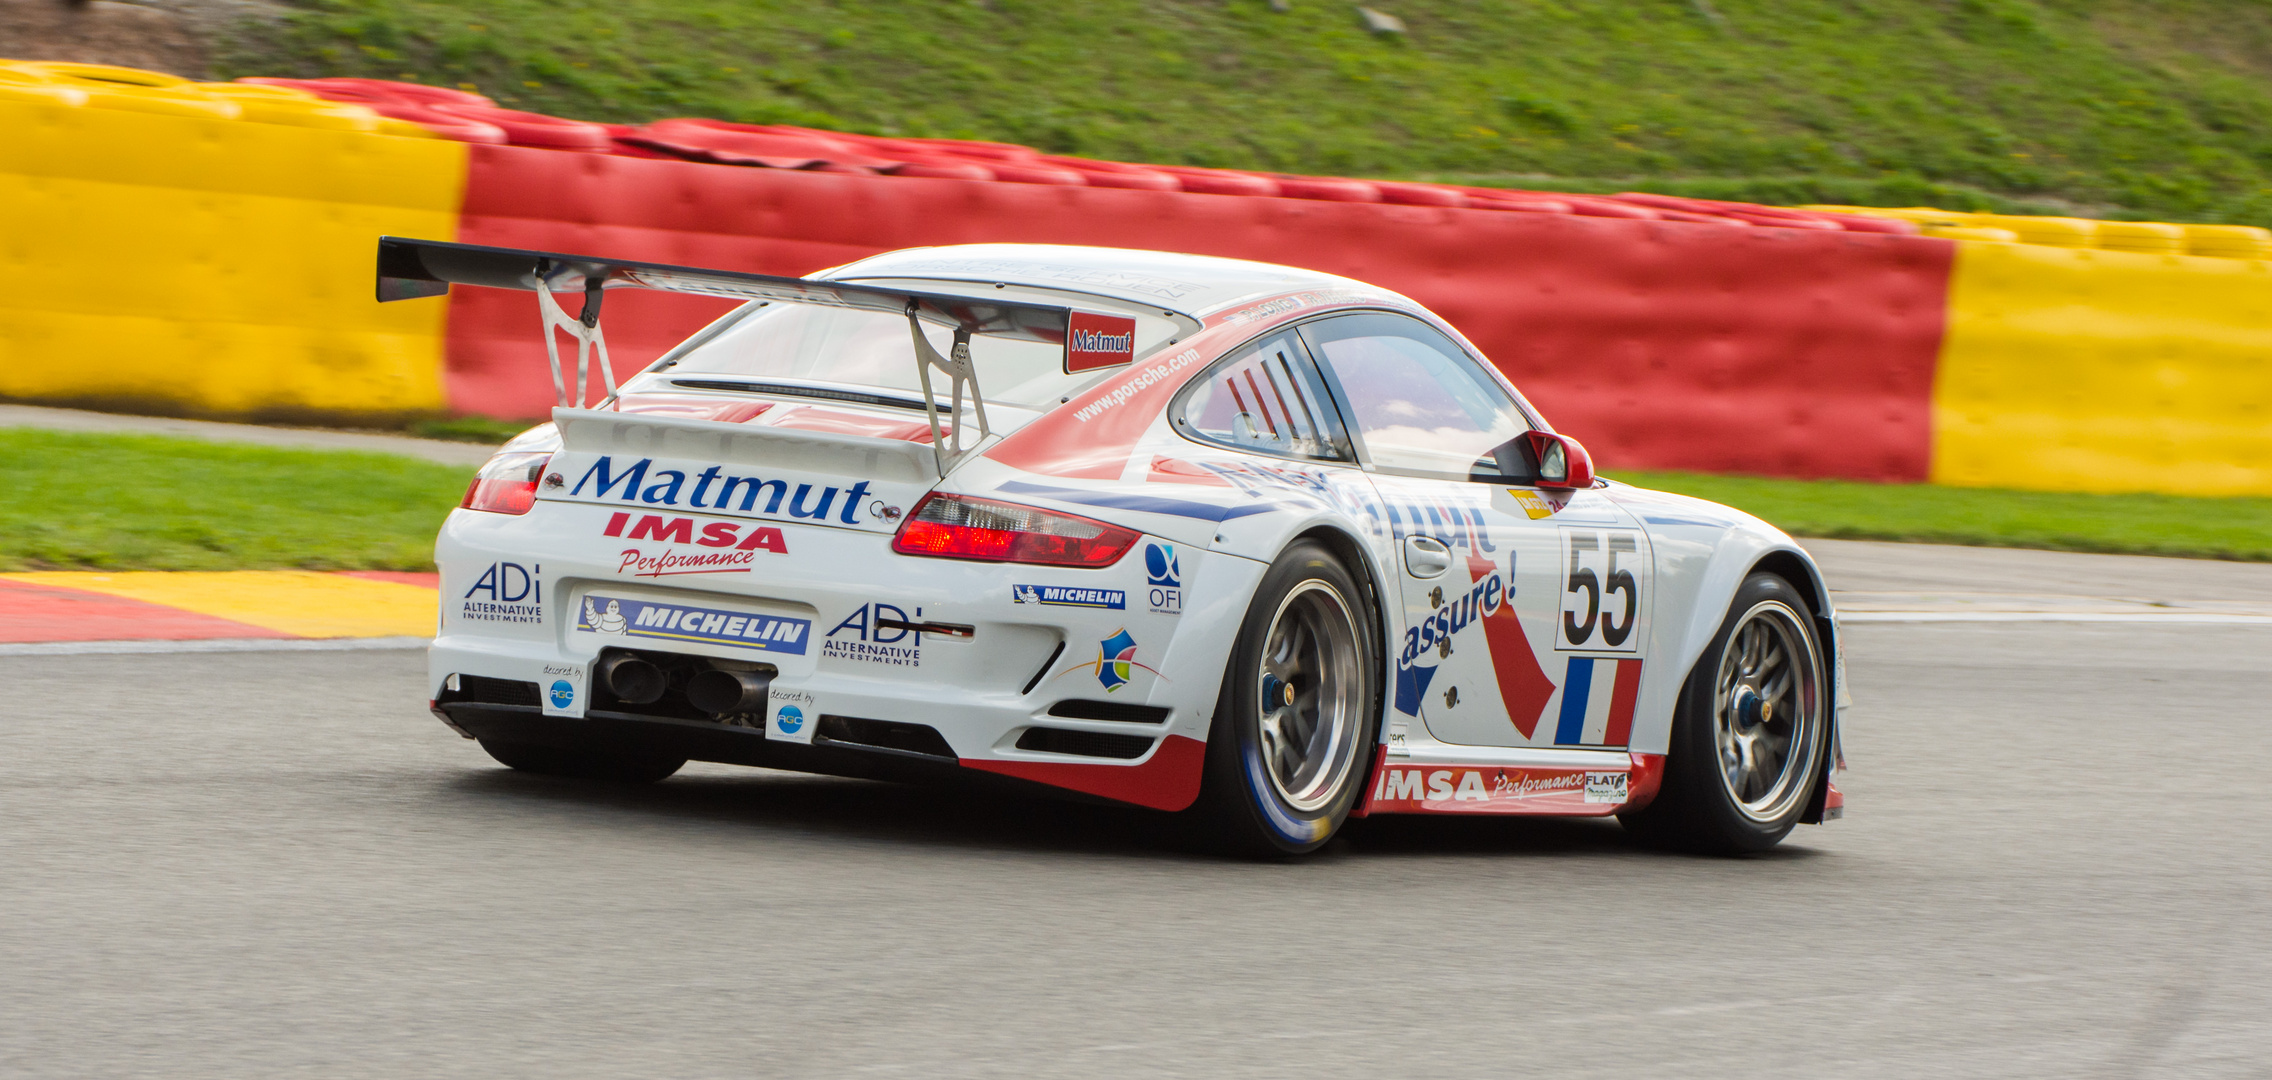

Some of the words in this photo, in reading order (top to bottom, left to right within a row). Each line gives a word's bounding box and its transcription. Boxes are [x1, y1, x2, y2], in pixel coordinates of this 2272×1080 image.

[1071, 329, 1131, 354] Matmut
[1073, 346, 1200, 424] www.porsche.com
[570, 456, 872, 525] Matmut
[603, 512, 789, 554] IMSA
[618, 549, 755, 577] Performance
[1043, 588, 1123, 604] MICHELIN
[1149, 588, 1181, 609] OFI
[1563, 531, 1637, 647] 55
[463, 602, 541, 616] ALTERNATIVE
[463, 612, 542, 623] INVESTMENTS
[634, 605, 804, 643] MICHELIN
[823, 650, 919, 667] INVESTMENTS
[824, 640, 920, 659] ALTERNATIVE
[543, 664, 572, 676] decored
[575, 667, 584, 682] by
[550, 689, 573, 700] AGC
[770, 689, 802, 701] decored
[805, 693, 815, 707] by
[777, 714, 802, 725] AGC
[1373, 769, 1490, 800] IMSA
[1493, 773, 1584, 800] Performance
